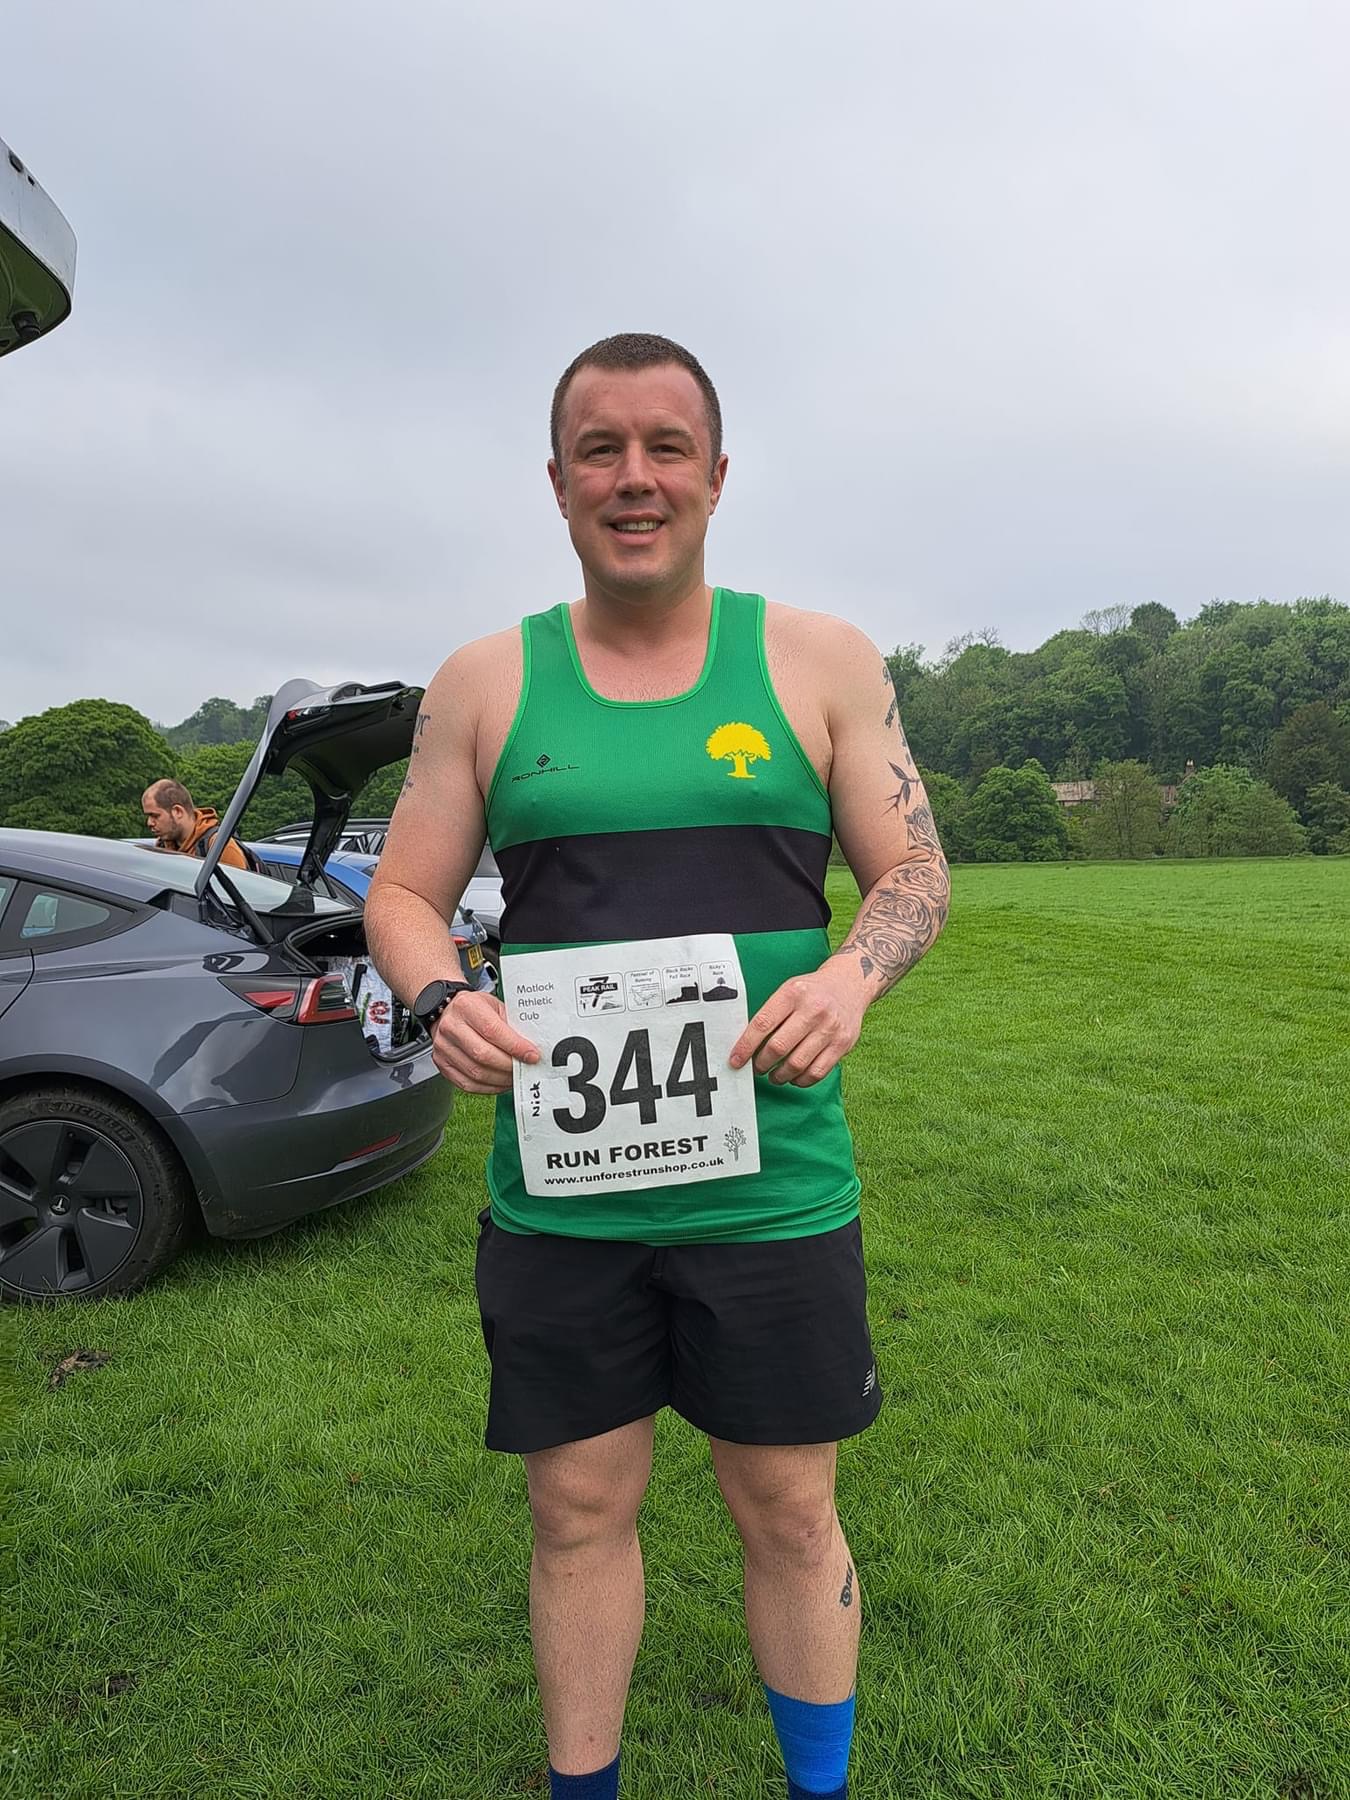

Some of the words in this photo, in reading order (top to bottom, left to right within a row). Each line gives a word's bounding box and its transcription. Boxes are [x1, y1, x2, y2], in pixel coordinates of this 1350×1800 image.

[511, 764, 580, 783] RONHILL
[516, 982, 555, 994] Matlock
[582, 985, 600, 993] PEAK
[600, 983, 617, 992] RAIL
[517, 996, 553, 1007] Athletic
[519, 1011, 540, 1022] Club
[551, 1020, 718, 1135] 344
[529, 1081, 541, 1117] Nick
[59, 1101, 137, 1142] MICHELIN
[546, 1149, 601, 1170] RUN
[609, 1135, 709, 1164] FOREST
[544, 1156, 725, 1185] www.runforestrunshop.co.uk
